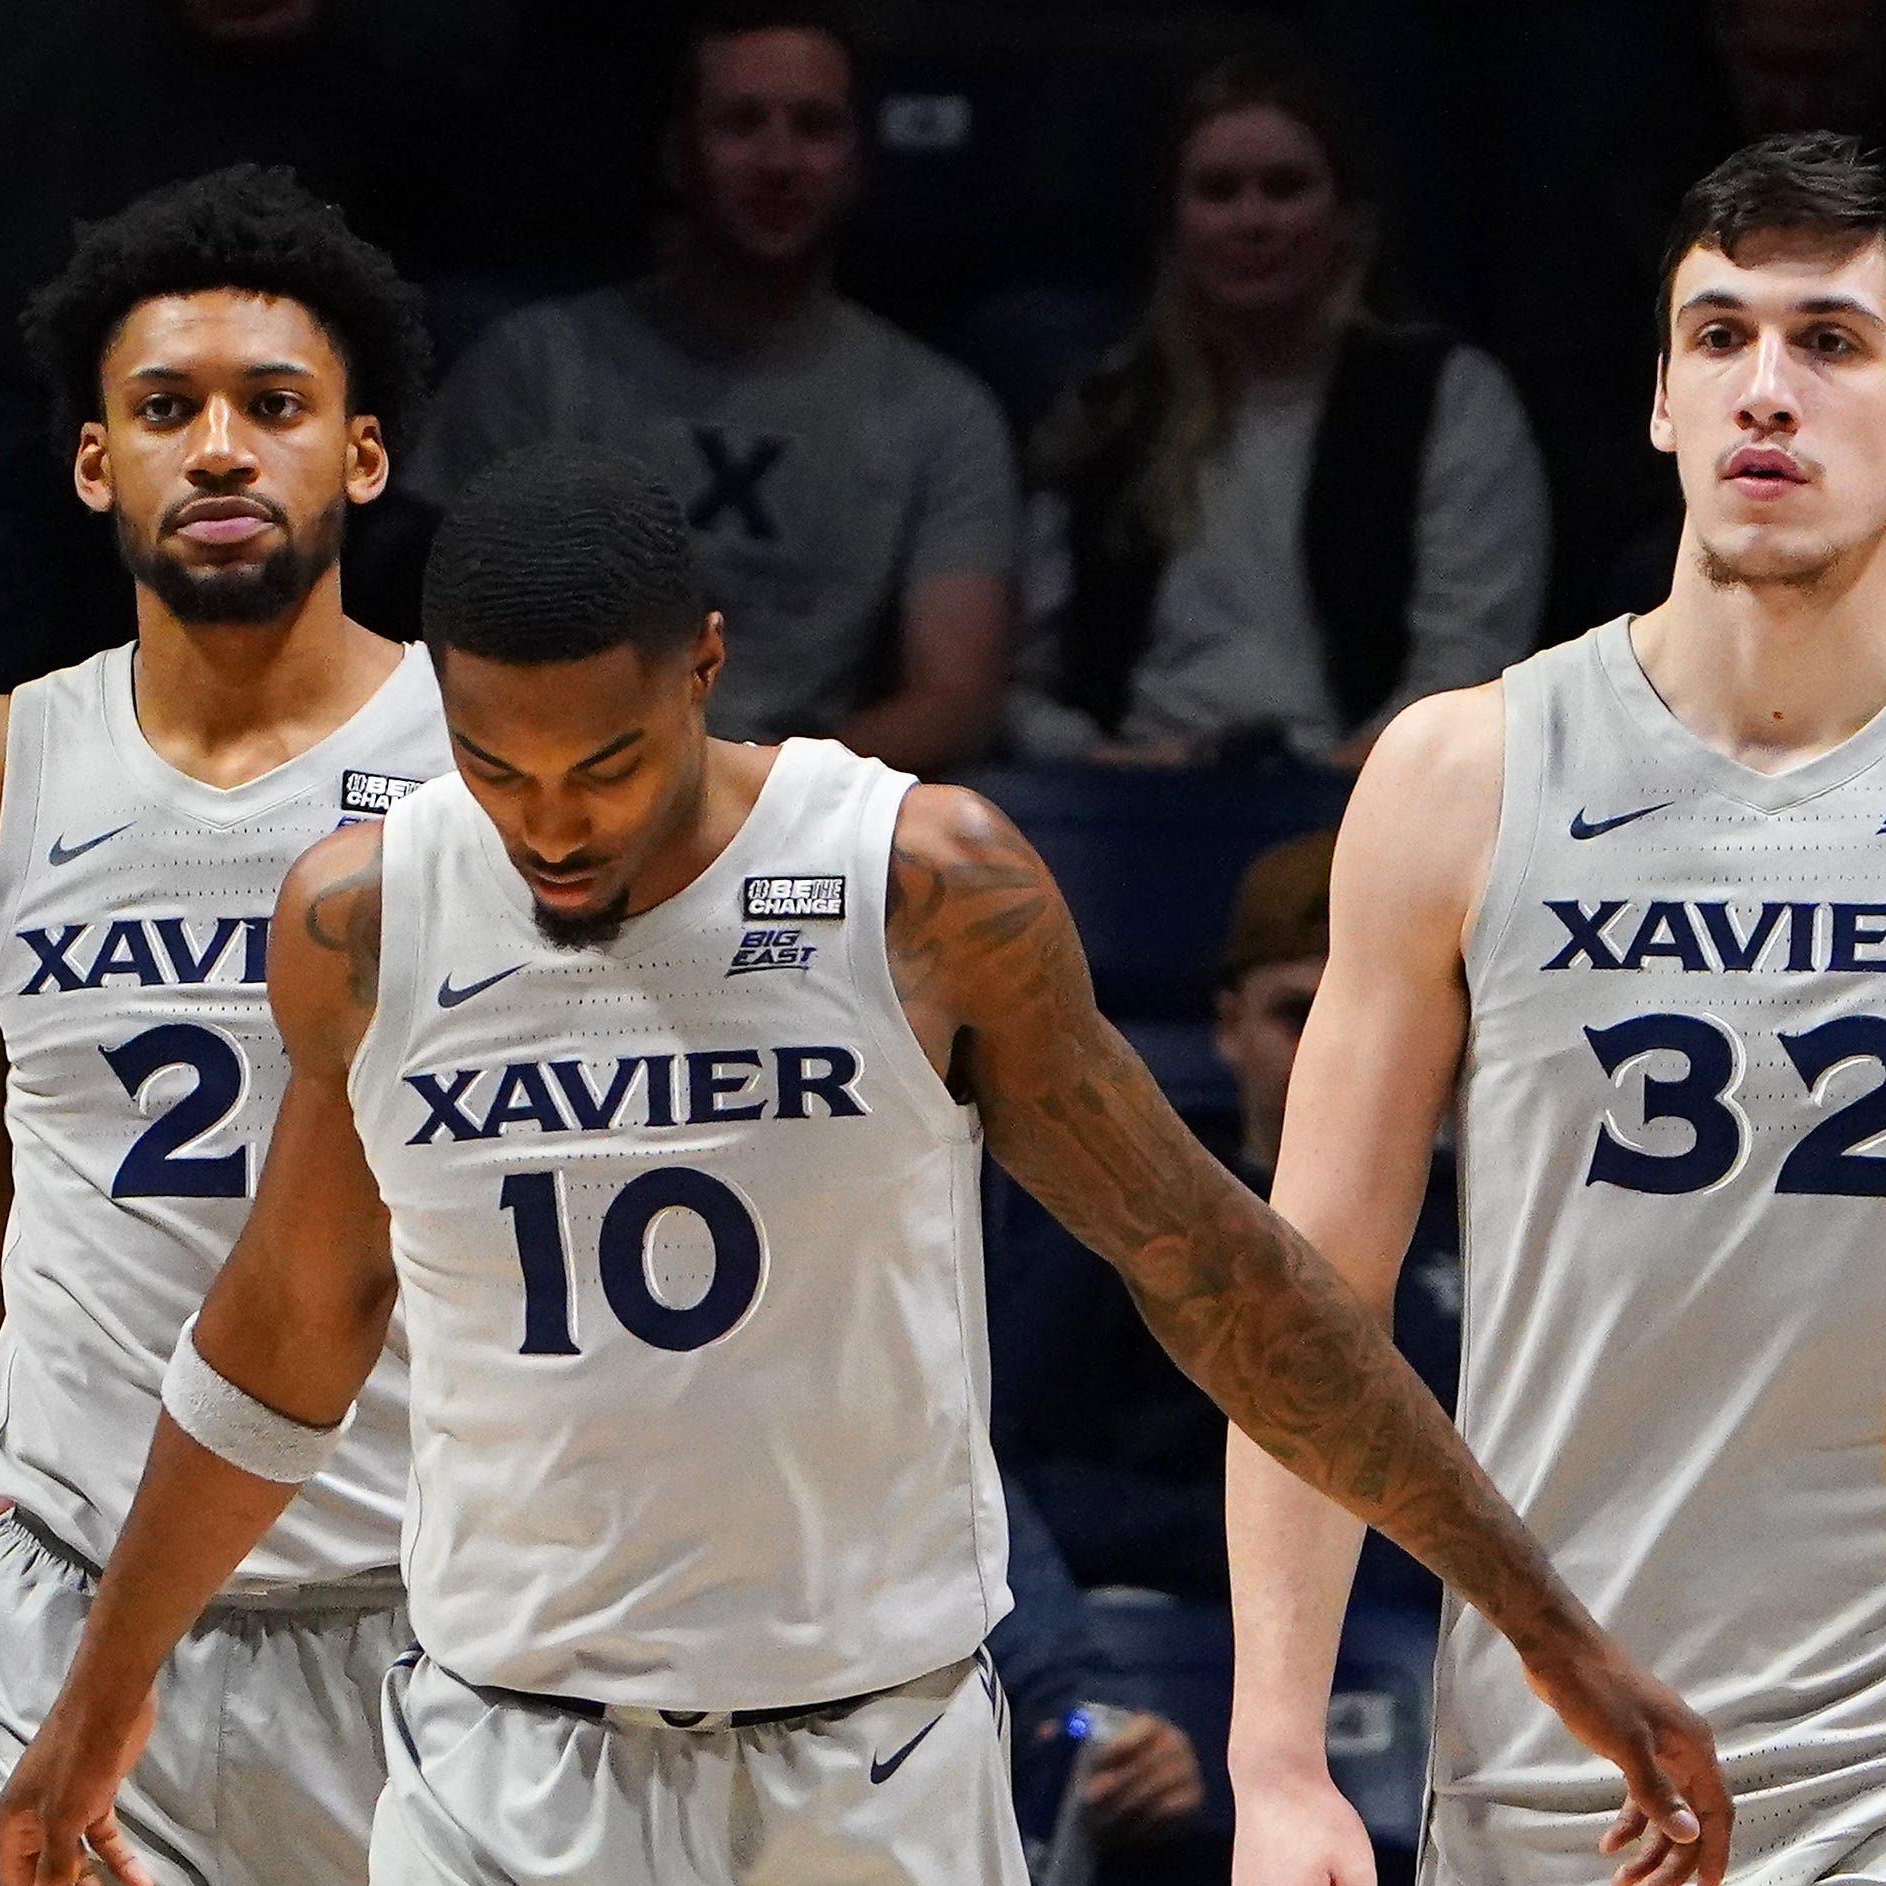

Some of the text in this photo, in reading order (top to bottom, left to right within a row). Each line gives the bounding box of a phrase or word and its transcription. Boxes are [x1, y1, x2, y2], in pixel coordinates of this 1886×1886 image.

[346, 791, 391, 810] CHA
[748, 898, 842, 915] CHANGE
[16, 917, 270, 996] XAVI
[731, 947, 817, 967] EAST
[740, 930, 802, 948] BIG
[97, 1022, 256, 1199] 2
[401, 1044, 874, 1146] XAVIER
[499, 1165, 771, 1356] 10
